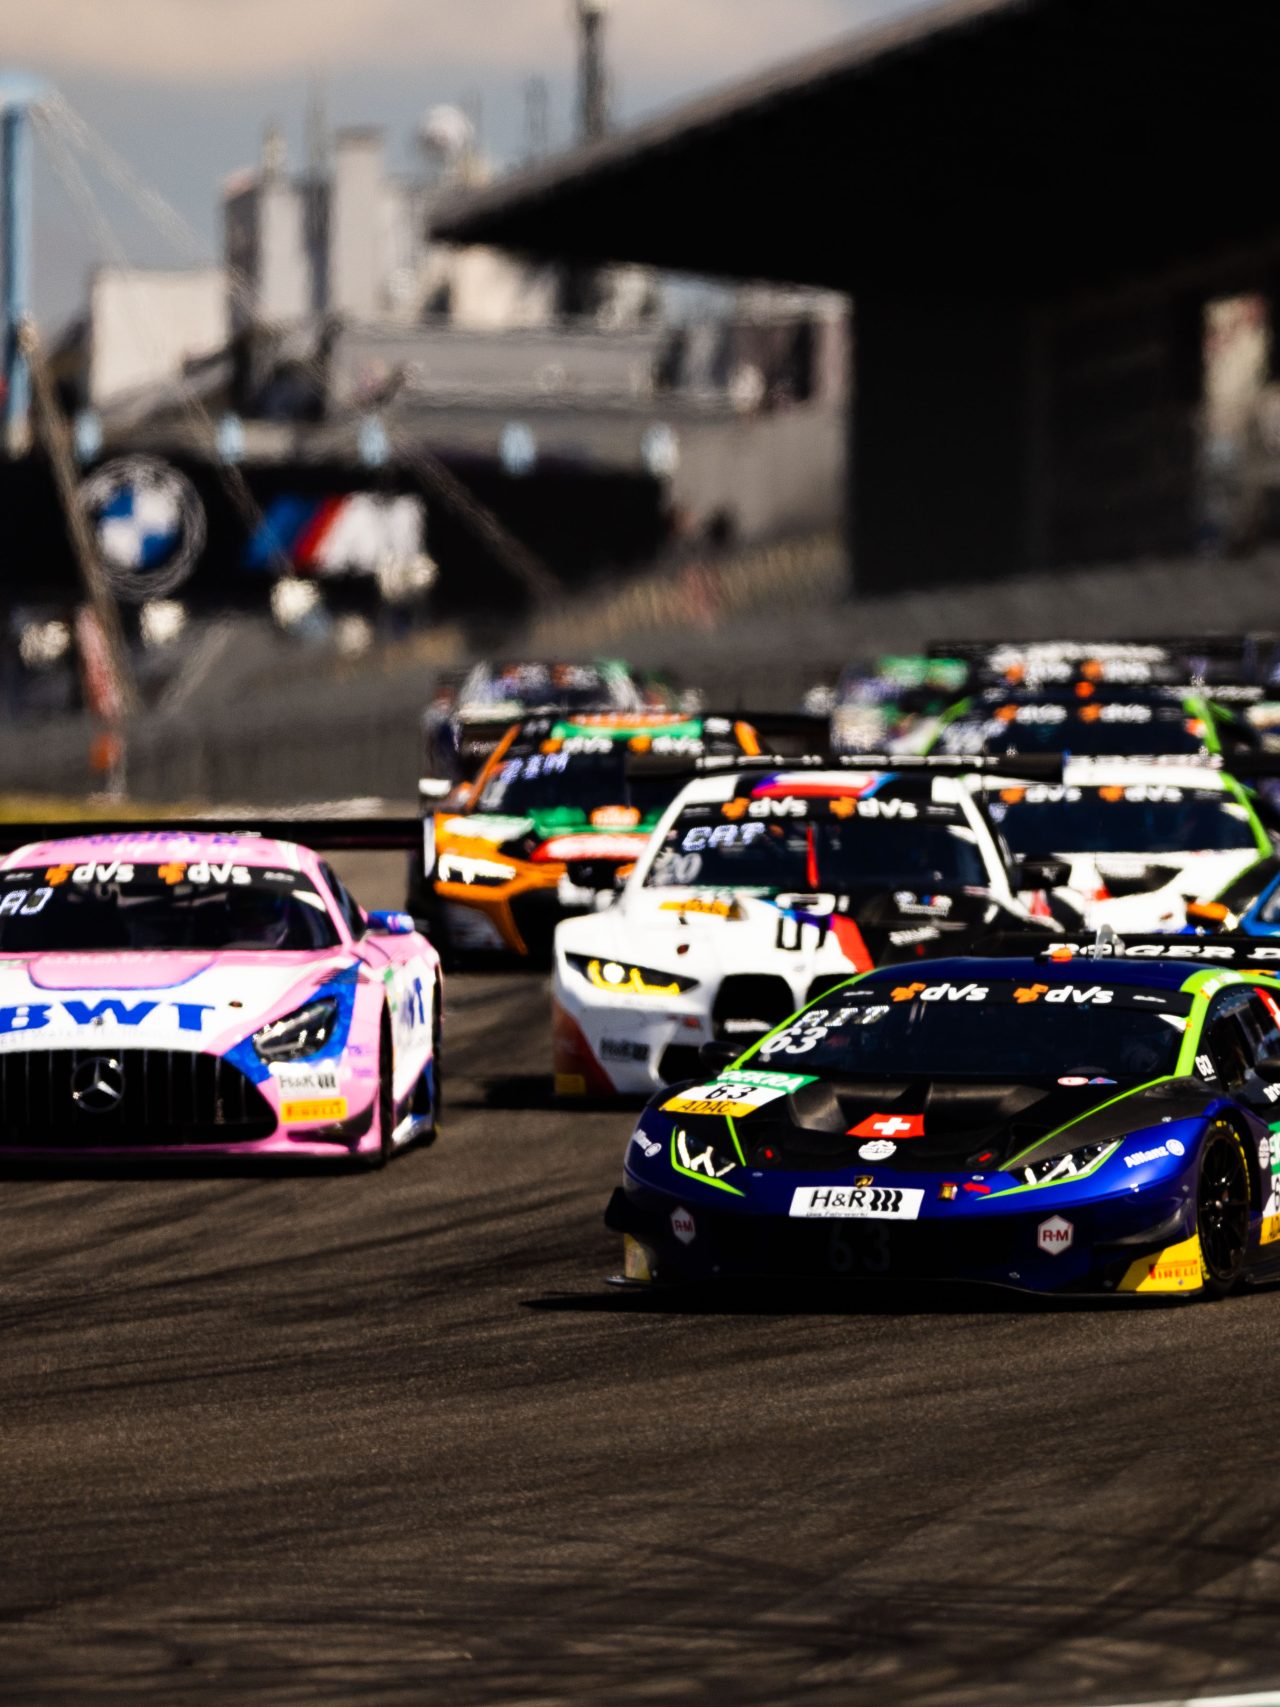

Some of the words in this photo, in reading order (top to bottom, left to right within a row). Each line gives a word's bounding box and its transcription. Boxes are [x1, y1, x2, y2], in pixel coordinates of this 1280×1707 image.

[748, 796, 808, 818] dvs
[857, 797, 918, 819] dvs
[682, 822, 766, 852] CAT
[72, 860, 135, 884] dvs
[187, 860, 252, 885] dvs
[0, 886, 54, 916] AJ
[919, 983, 990, 1003] dvs
[1044, 985, 1114, 1005] dvs
[0, 998, 217, 1034] BWT
[760, 1025, 829, 1054] 63
[704, 1084, 758, 1100] 63
[717, 1070, 804, 1093] DEKRA
[678, 1101, 739, 1114] ADAC
[1123, 1146, 1170, 1168] Allianz
[809, 1188, 868, 1209] H&R
[1042, 1228, 1070, 1243] R-M
[1149, 1259, 1198, 1280] PIRELLI
